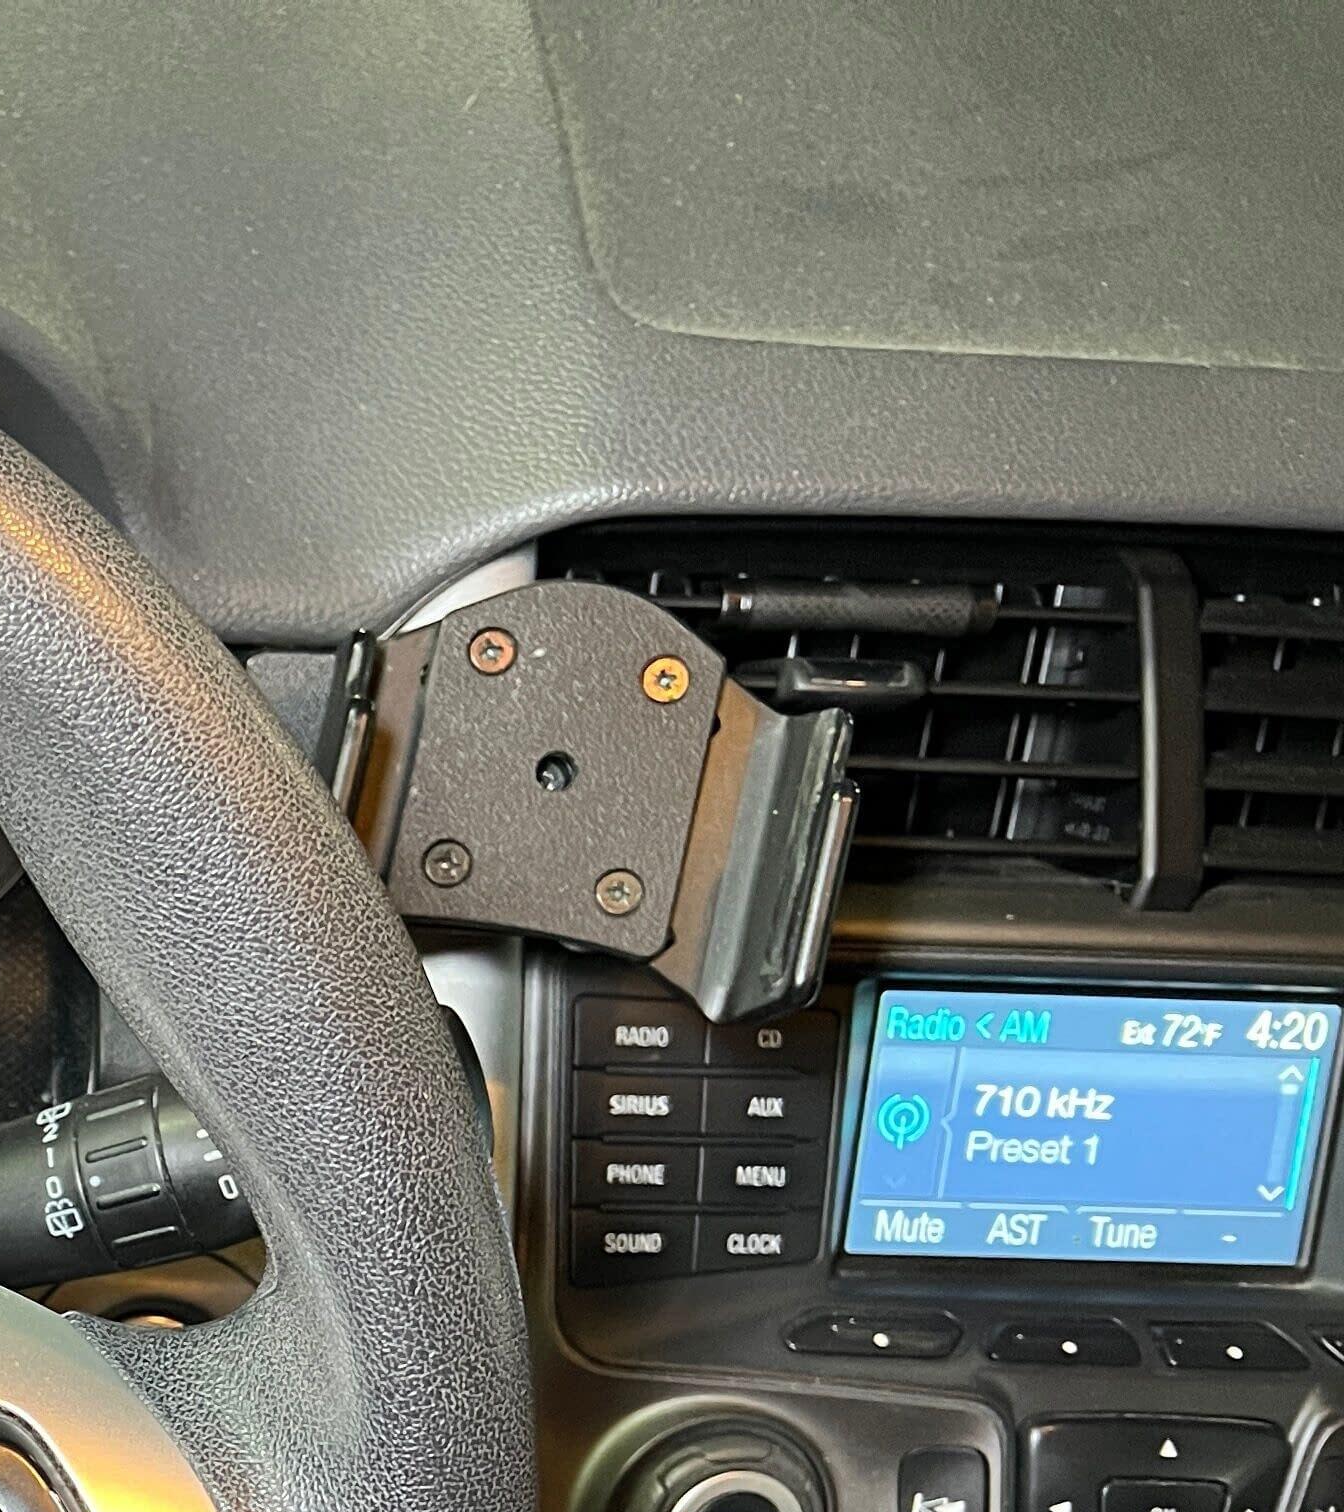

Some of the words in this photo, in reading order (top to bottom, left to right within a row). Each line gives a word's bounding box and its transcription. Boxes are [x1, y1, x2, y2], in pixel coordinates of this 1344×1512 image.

[886, 1006, 966, 1042] Radio
[999, 1009, 1053, 1044] AM
[1246, 1009, 1329, 1051] 4:20
[615, 1026, 669, 1047] RADIO
[757, 1029, 783, 1049] CD
[608, 1094, 670, 1116] SIRIUS
[746, 1096, 784, 1118] AUX
[974, 1084, 1041, 1118] 710
[1047, 1087, 1115, 1121] kHz
[42, 1123, 59, 1143] 2
[965, 1131, 1074, 1165] Preset
[1083, 1134, 1100, 1166] 1
[606, 1163, 665, 1186] PHONE
[735, 1165, 786, 1188] MENU
[873, 1209, 946, 1245] Mute
[986, 1213, 1049, 1247] AST
[1088, 1215, 1158, 1249] Tune
[604, 1232, 662, 1254] SOUND
[726, 1233, 783, 1255] CLOCK
